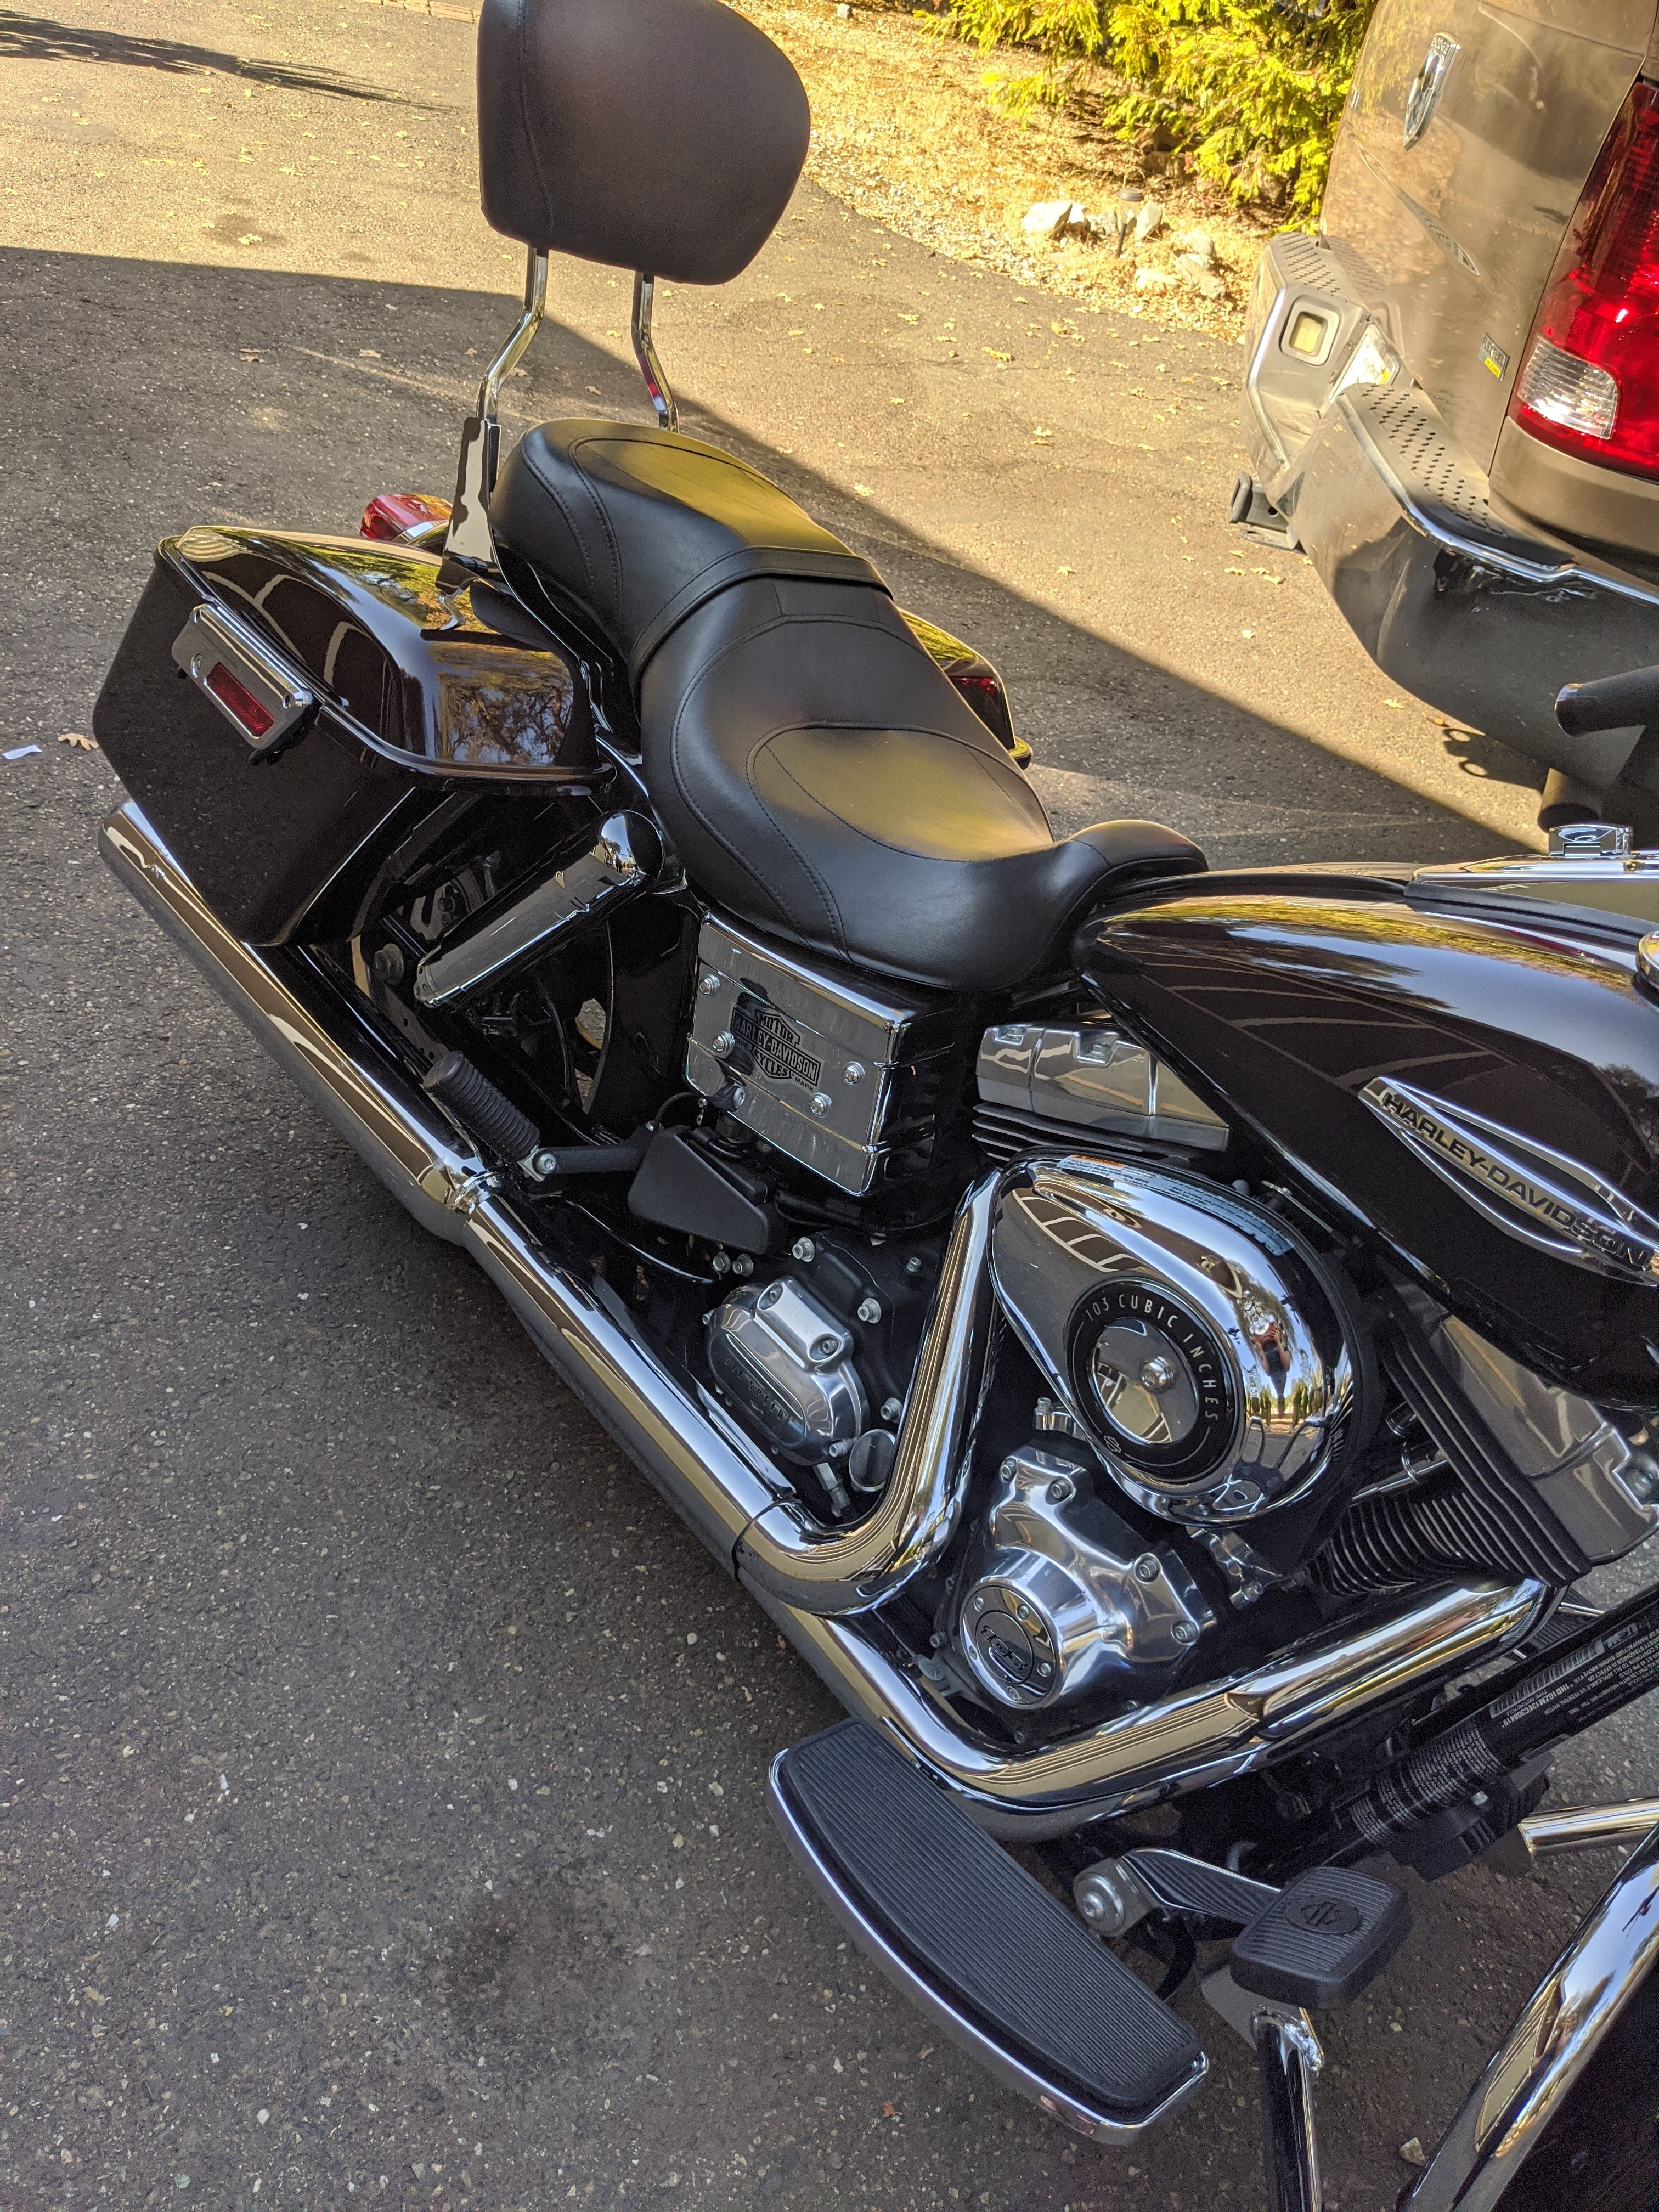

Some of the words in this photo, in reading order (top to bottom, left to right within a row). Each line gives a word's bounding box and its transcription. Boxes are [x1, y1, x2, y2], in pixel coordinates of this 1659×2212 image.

[733, 1015, 817, 1080] HARLEY-DAVIDSON
[757, 1014, 794, 1042] MOTOR
[755, 1051, 788, 1076] CYCLES
[794, 1077, 814, 1092] MARK
[1383, 1092, 1653, 1269] HARLEY-DAVIDSON
[724, 1356, 744, 1380] SIX
[748, 1380, 783, 1420] SPEED
[1085, 1297, 1109, 1321] 103
[1119, 1294, 1178, 1328] CUBIC
[1183, 1333, 1218, 1421] INCHES
